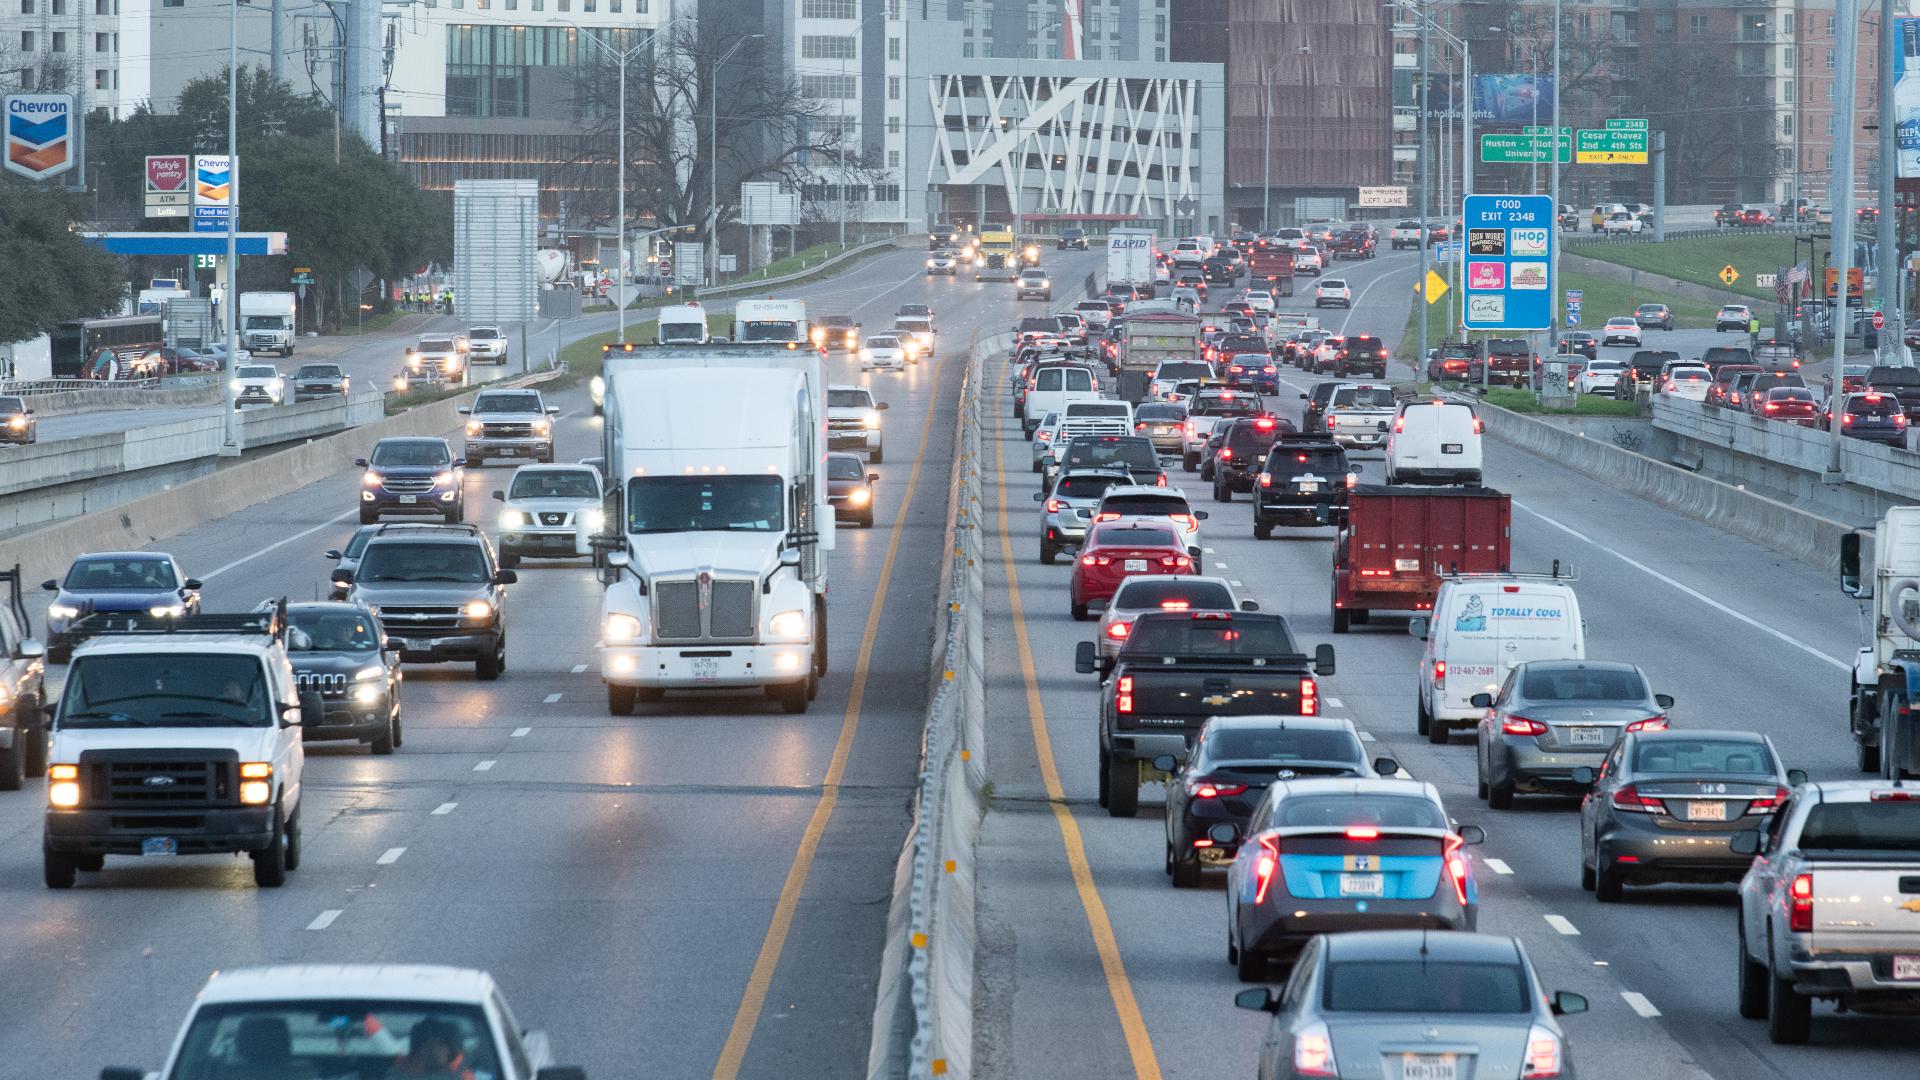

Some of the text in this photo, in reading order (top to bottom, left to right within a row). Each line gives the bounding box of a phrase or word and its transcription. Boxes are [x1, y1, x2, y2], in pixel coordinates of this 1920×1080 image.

[9, 99, 67, 113] Chevron
[1582, 132, 1642, 140] Cesar Chavez
[1485, 140, 1517, 148] Huston
[1528, 140, 1568, 148] Tlloton
[1582, 141, 1599, 149] 2nd
[1610, 141, 1626, 149] 4th
[1629, 141, 1642, 149] Sts
[1505, 150, 1547, 159] Univerity
[152, 160, 180, 171] Picky's
[198, 159, 229, 167] Chevro
[160, 195, 176, 203] ATM
[1495, 200, 1521, 209] FOOD
[157, 207, 176, 216] Lotto
[1481, 212, 1535, 221] EXIT 234B
[1113, 239, 1147, 248] RAPID
[1473, 276, 1500, 287] Wendy's
[1568, 302, 1580, 311] 35
[1491, 608, 1562, 618] TOTALLY COOL
[1449, 666, 1494, 675] 512-467-2689
